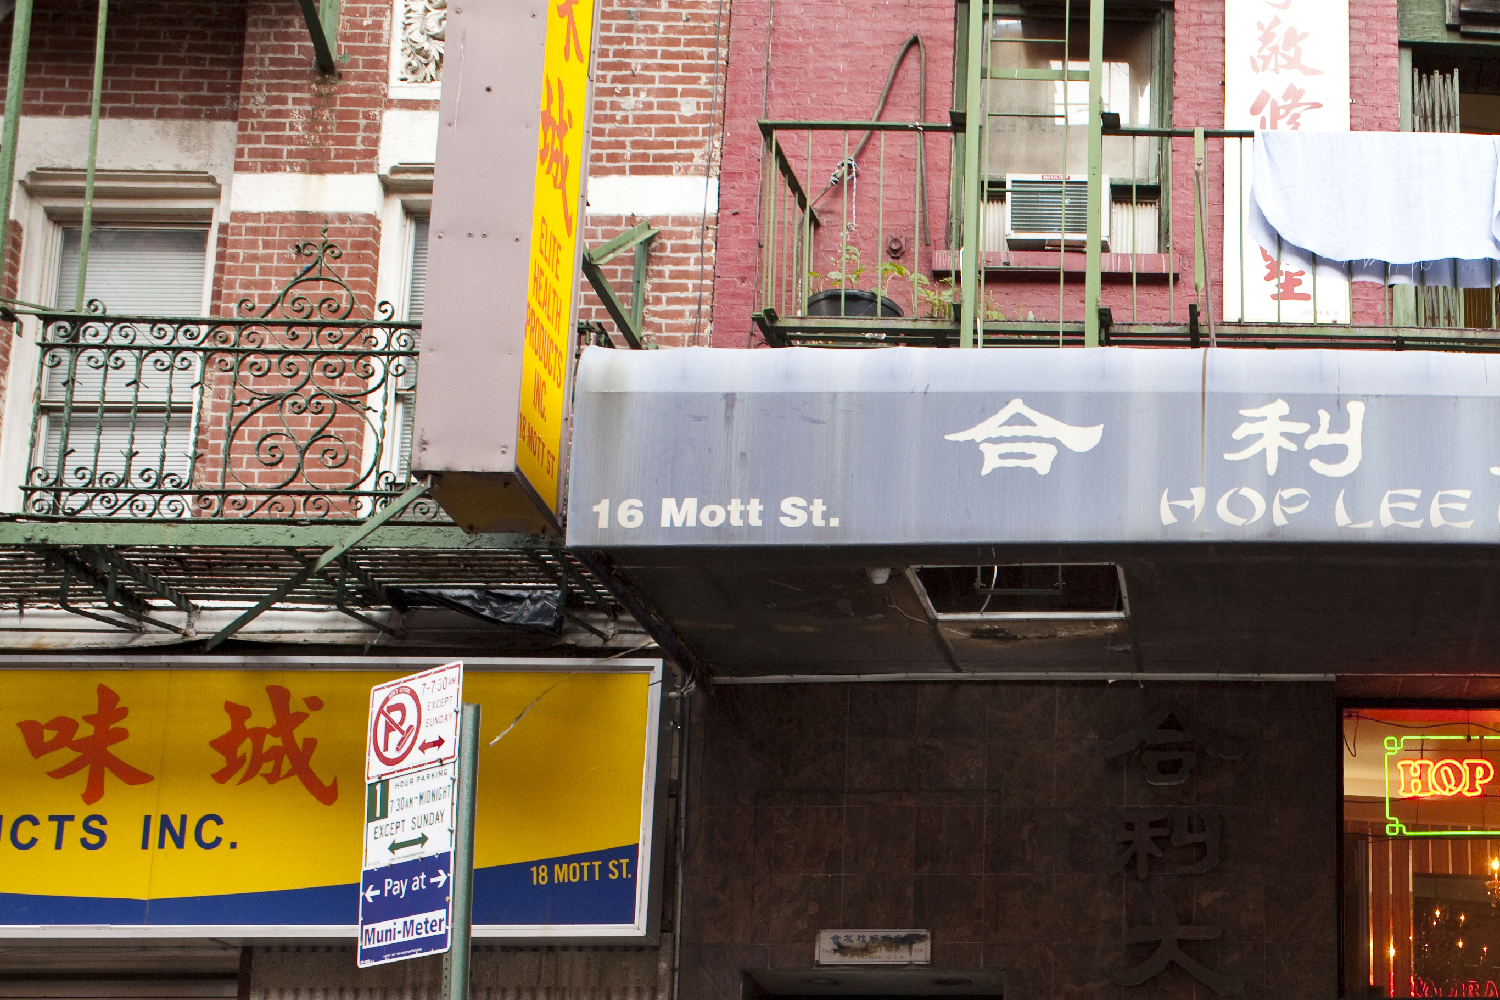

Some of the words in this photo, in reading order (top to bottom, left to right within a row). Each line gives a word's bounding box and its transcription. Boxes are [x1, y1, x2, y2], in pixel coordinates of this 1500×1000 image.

[539, 215, 562, 282] ELITE
[532, 259, 562, 336] HEALTH
[524, 300, 563, 389] PRODUCTS
[532, 368, 547, 423] INC.
[518, 411, 526, 440] 18
[527, 422, 546, 467] MOTT
[591, 498, 643, 529] 16
[660, 497, 763, 528] Mott
[778, 498, 840, 528] St.
[1159, 485, 1311, 528] HOP
[1335, 487, 1475, 531] LEE
[425, 713, 453, 728] SUNDAY
[427, 695, 453, 712] EXCEPT
[16, 684, 339, 806] 味城
[394, 778, 414, 789] HOUR
[416, 768, 448, 782] PARKING
[1396, 759, 1494, 799] HOP
[375, 783, 381, 817] 1
[0, 814, 108, 850] CTS
[141, 813, 238, 850] INC.
[373, 819, 405, 840] EXCEPT
[411, 809, 445, 830] SUNDAY
[384, 878, 408, 899] Pay
[411, 872, 426, 891] at
[530, 865, 548, 885] 18
[554, 861, 602, 883] MOTT
[608, 859, 632, 879] ST.
[364, 917, 445, 947] Muni-Meter
